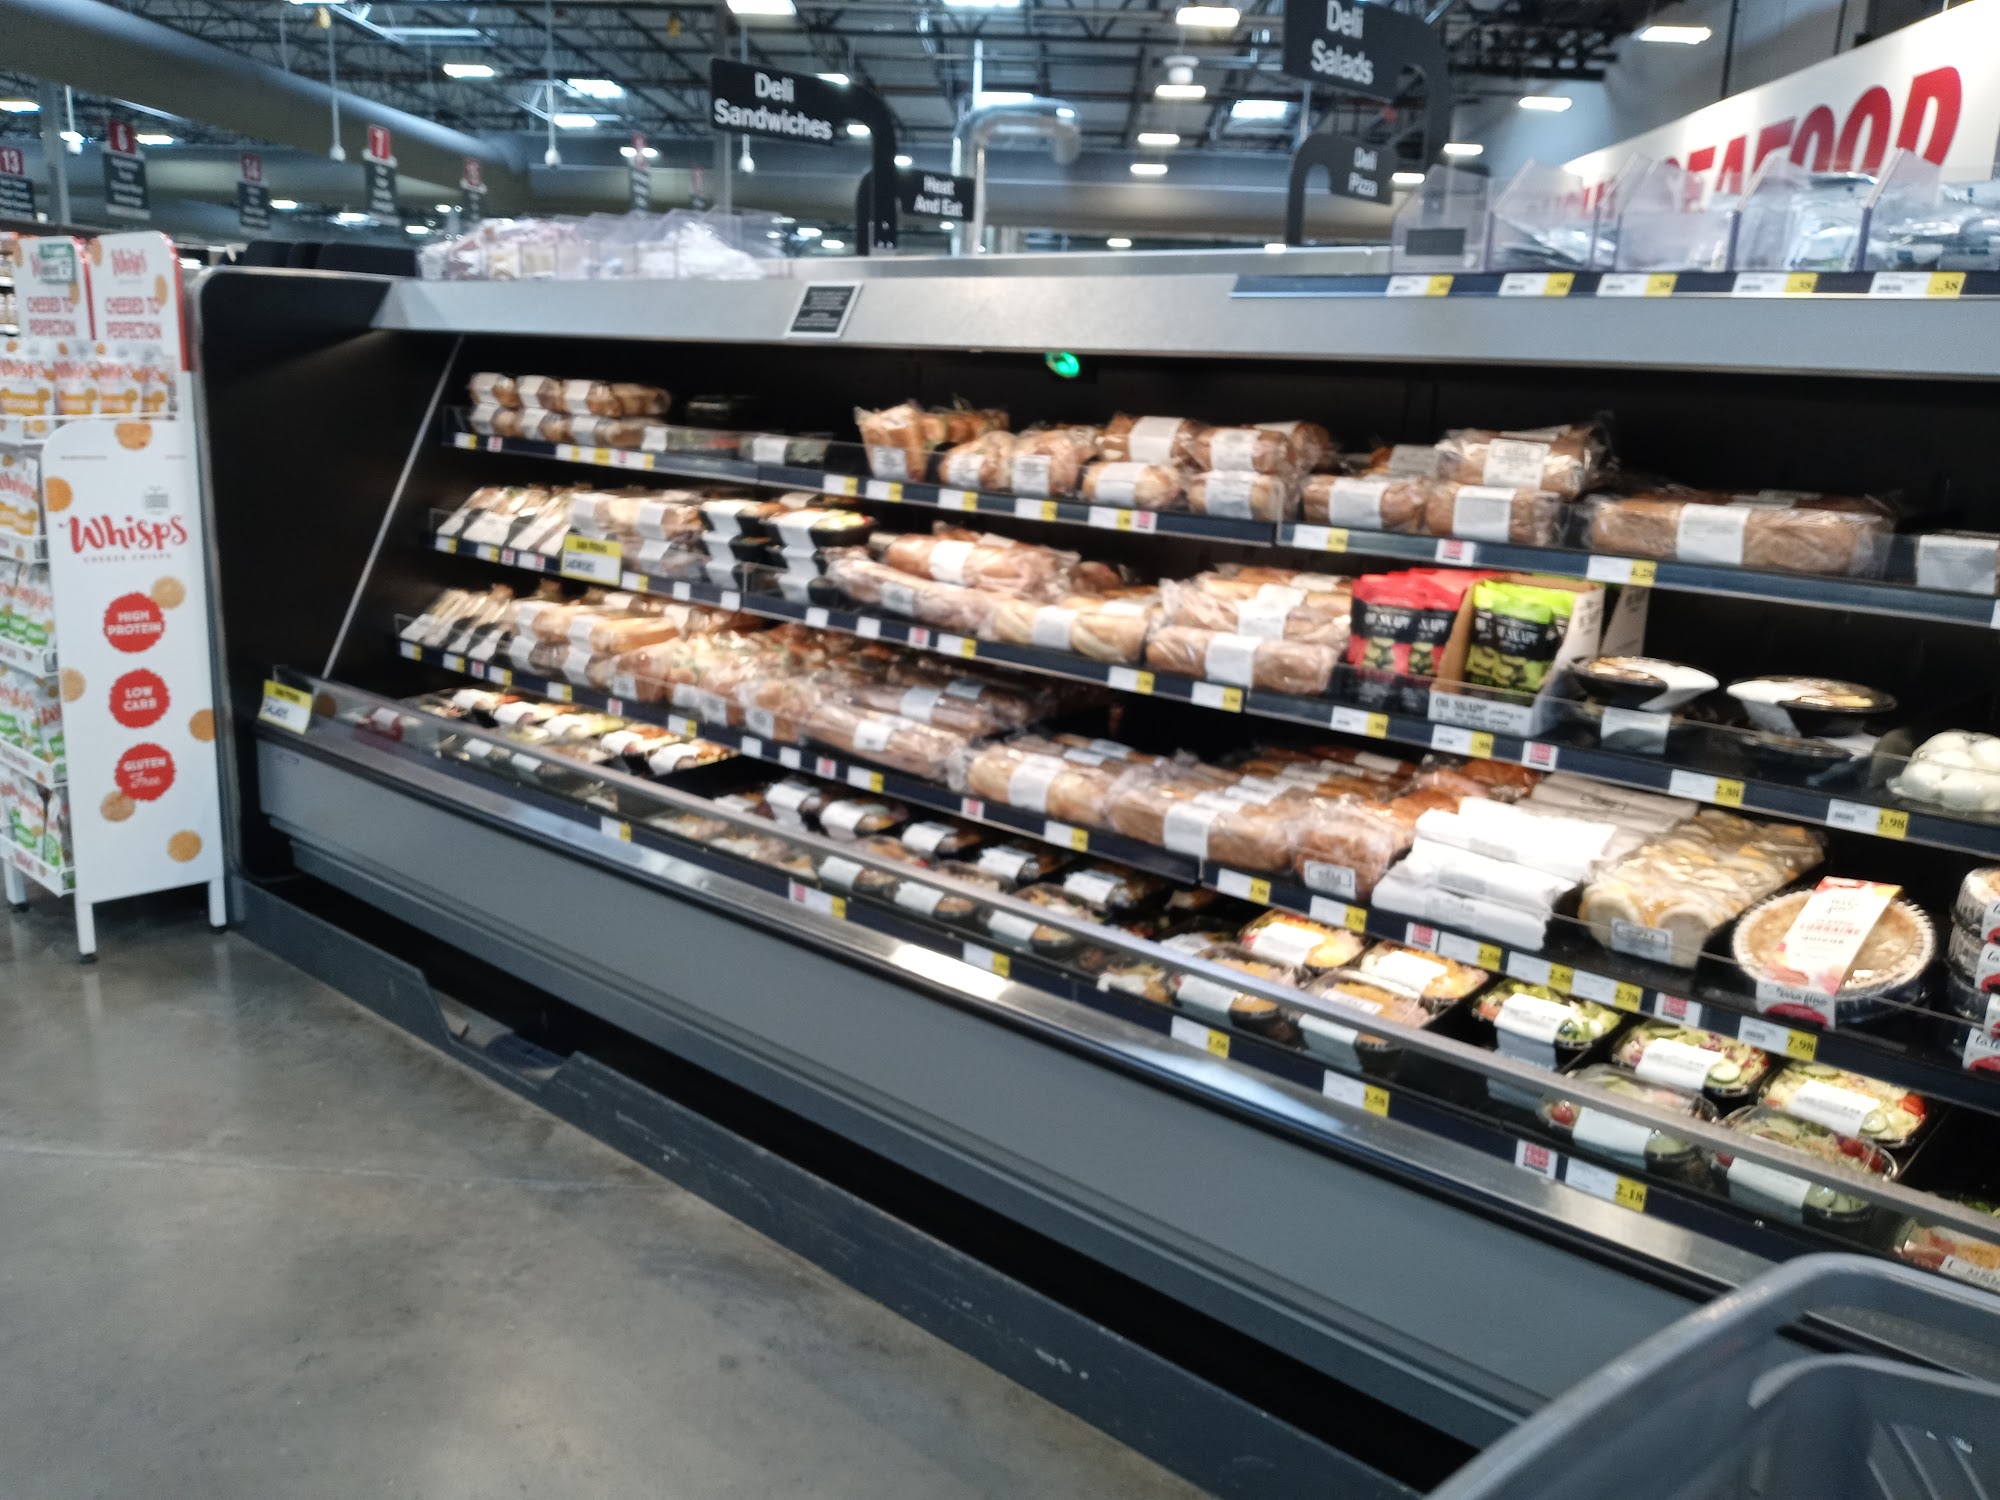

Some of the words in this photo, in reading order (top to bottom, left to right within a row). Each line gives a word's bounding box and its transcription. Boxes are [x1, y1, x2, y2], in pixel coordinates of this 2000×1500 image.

[1327, 0, 1364, 39] Deli
[1311, 38, 1374, 85] Salads
[754, 71, 794, 102] Deli
[714, 97, 833, 140] Sandwiches
[1353, 147, 1378, 171] Deli
[923, 175, 955, 196] Heat
[1348, 172, 1378, 197] Pizza
[914, 194, 940, 214] And
[941, 199, 963, 217] Eat
[58, 515, 188, 553] Whisps
[117, 609, 150, 623] HIGH
[107, 621, 162, 636] PROTEIN
[125, 686, 153, 699] LOW
[122, 697, 158, 712] CARB
[122, 756, 167, 773] GLUTEN
[130, 771, 162, 788] Free
